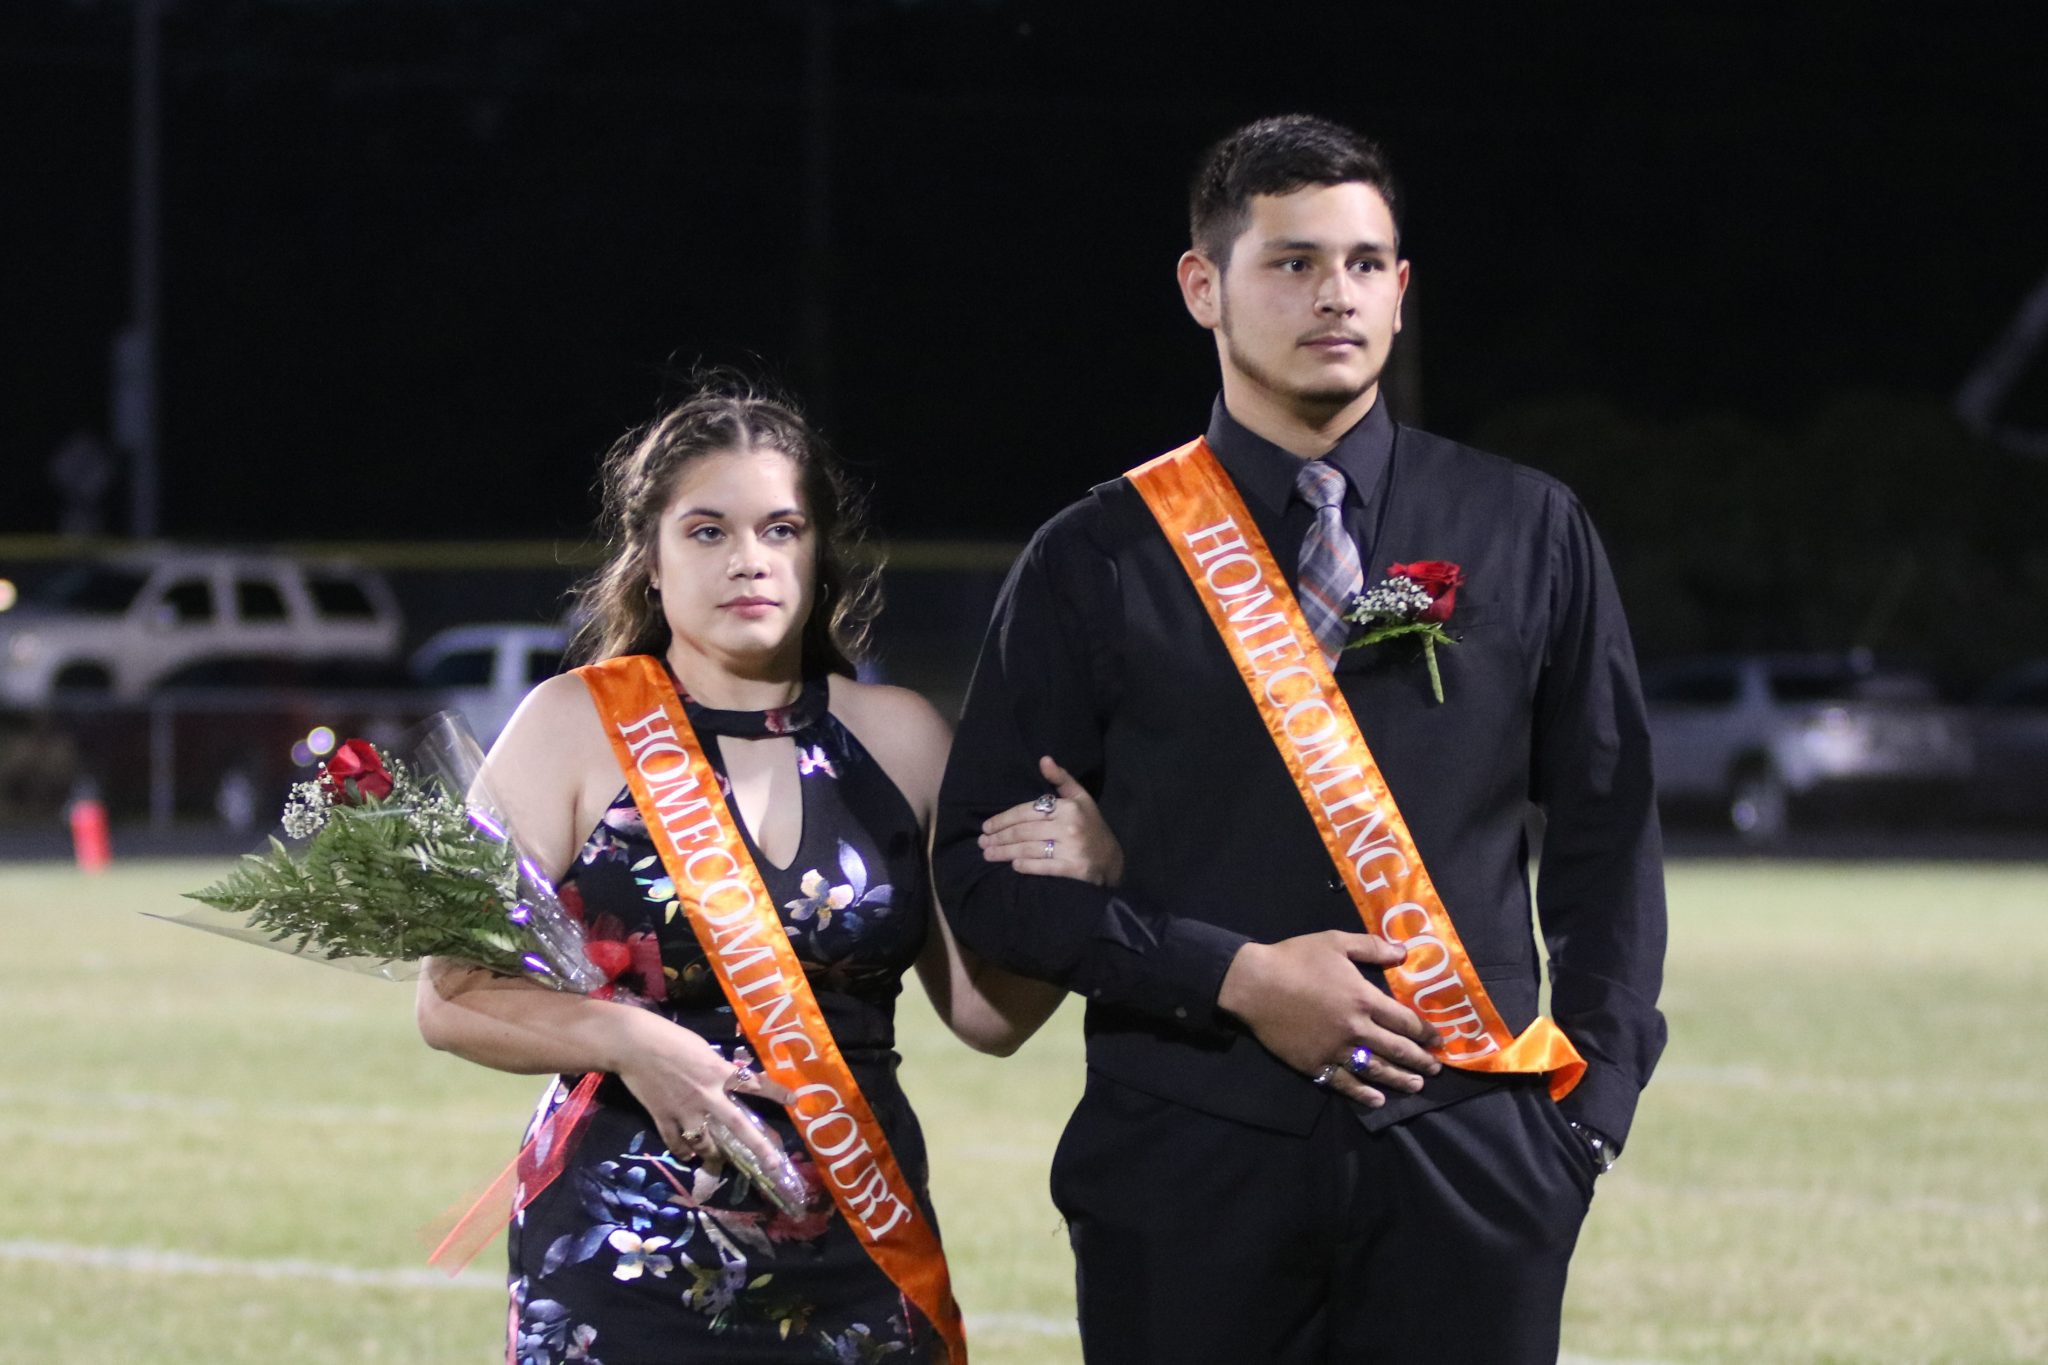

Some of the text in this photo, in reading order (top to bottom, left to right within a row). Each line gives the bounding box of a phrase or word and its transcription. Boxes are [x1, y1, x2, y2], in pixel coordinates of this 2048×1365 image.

[618, 704, 912, 1242] HOMECOMING COURT
[1184, 515, 1501, 1061] HOMECOMING COURT
